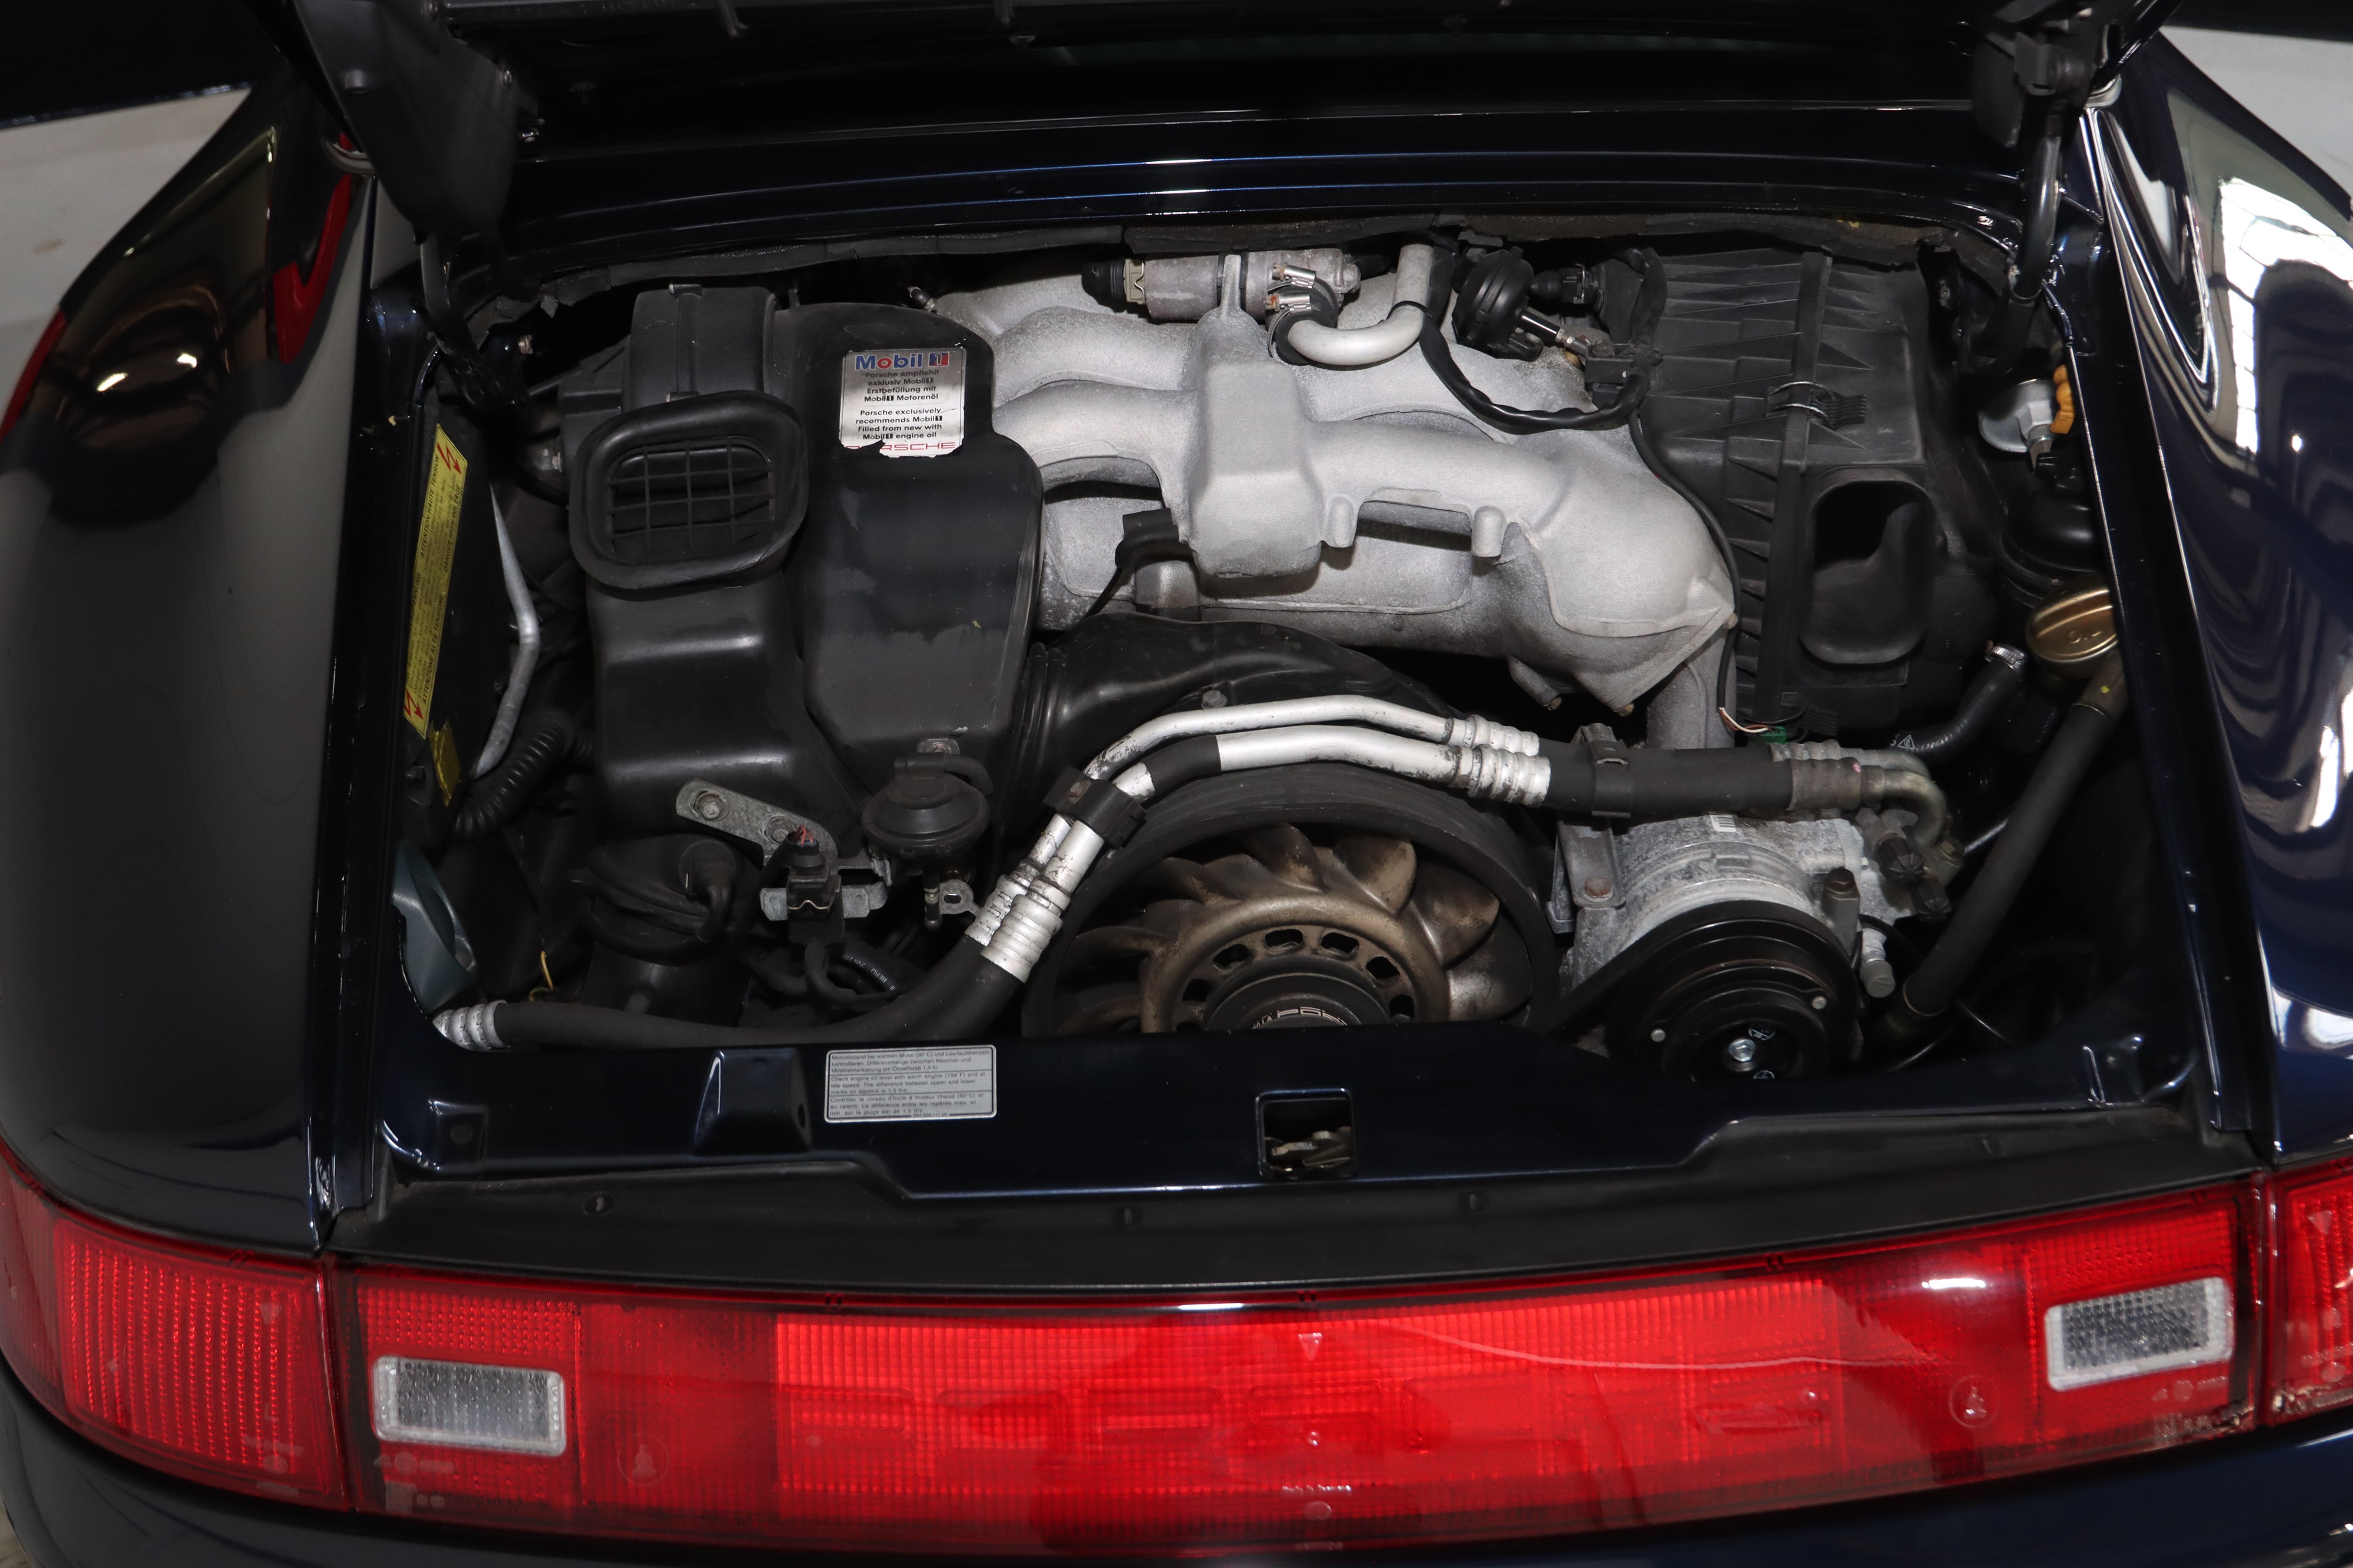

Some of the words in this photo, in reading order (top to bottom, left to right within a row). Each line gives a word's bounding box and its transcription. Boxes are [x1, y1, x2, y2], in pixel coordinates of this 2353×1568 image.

[855, 353, 923, 371] Mobil
[901, 369, 939, 378] empfiehlt
[419, 515, 429, 558] ATTENTION
[431, 453, 439, 486] TENSION
[444, 540, 452, 572] DANGER
[452, 483, 460, 518] VOLTAGE
[422, 655, 434, 706] ATTENZIONE
[434, 593, 443, 631] TENSIONE
[871, 968, 888, 983] BERU
